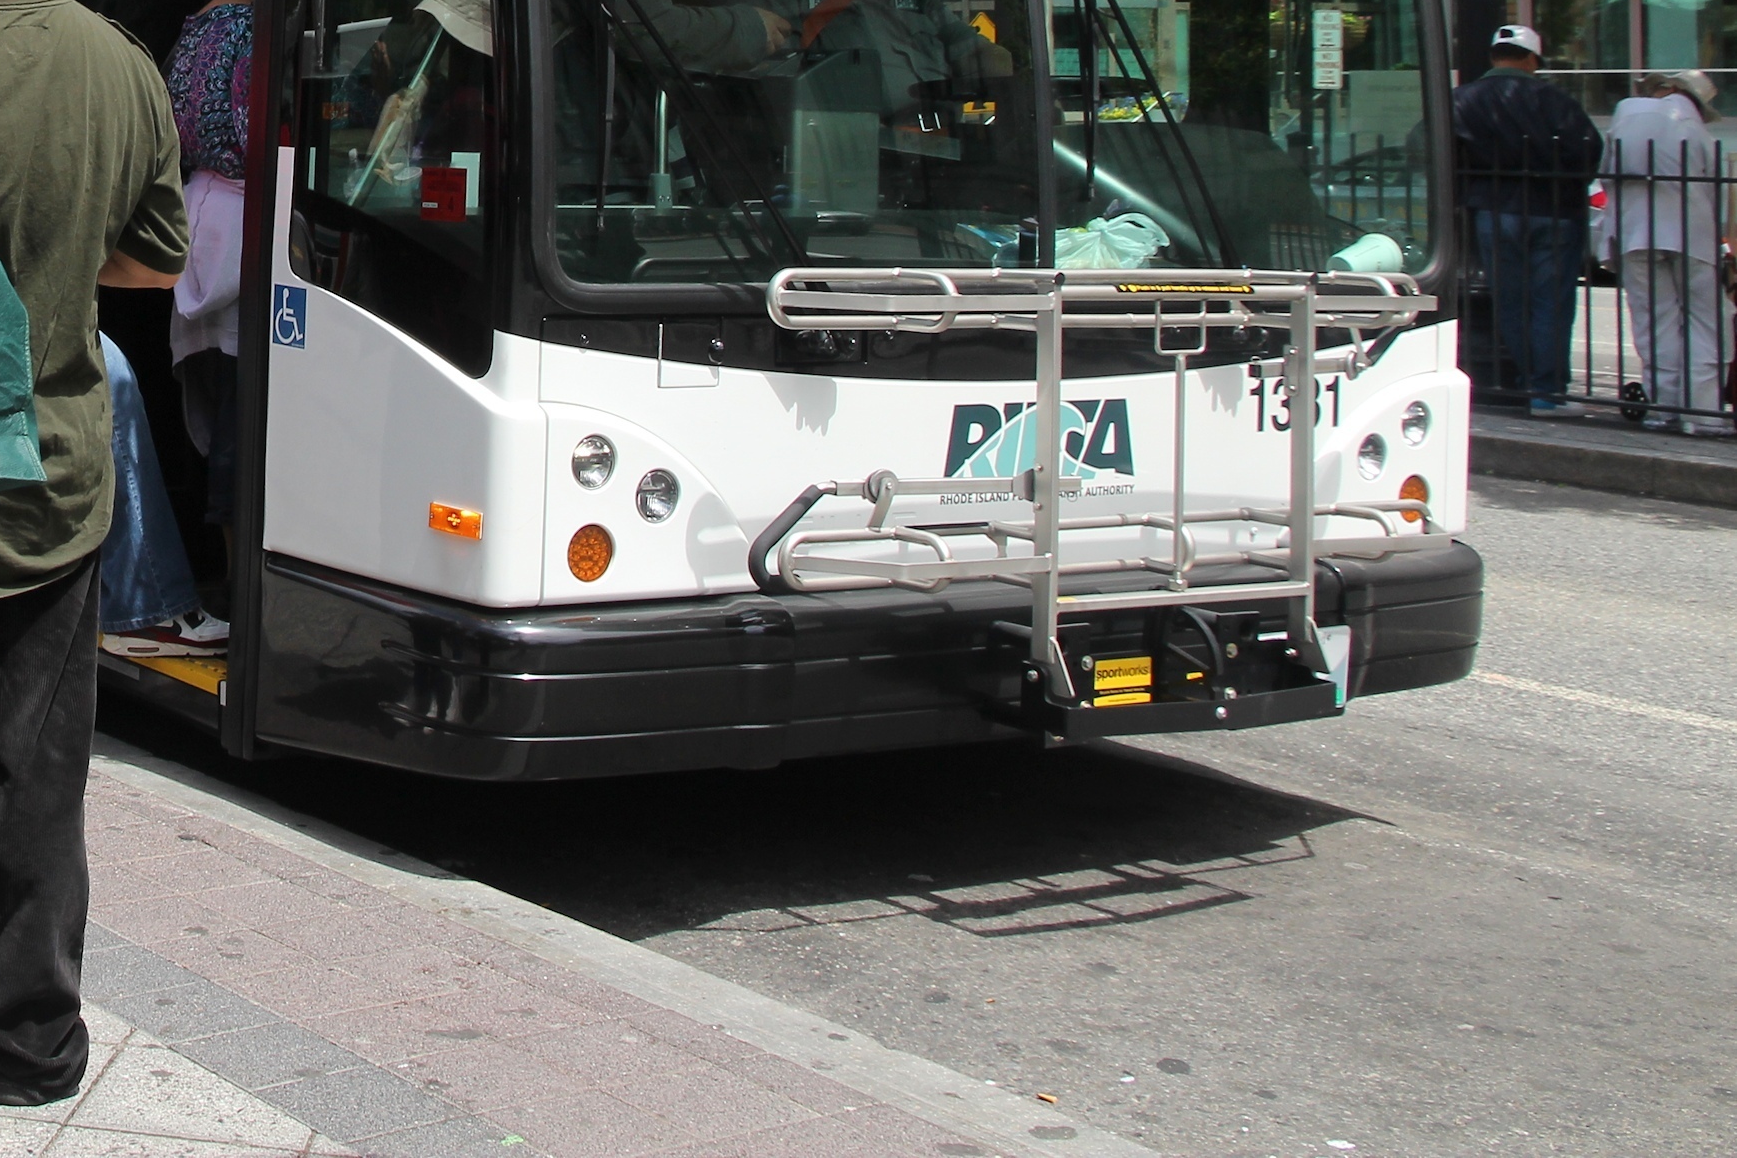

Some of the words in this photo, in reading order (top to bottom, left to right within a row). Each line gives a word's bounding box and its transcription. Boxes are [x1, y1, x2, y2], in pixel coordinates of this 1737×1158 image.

[940, 492, 972, 506] RHODE
[975, 492, 1009, 503] ISLAND
[1085, 483, 1135, 497] AUTHORITY
[1096, 666, 1149, 682] sportworks
